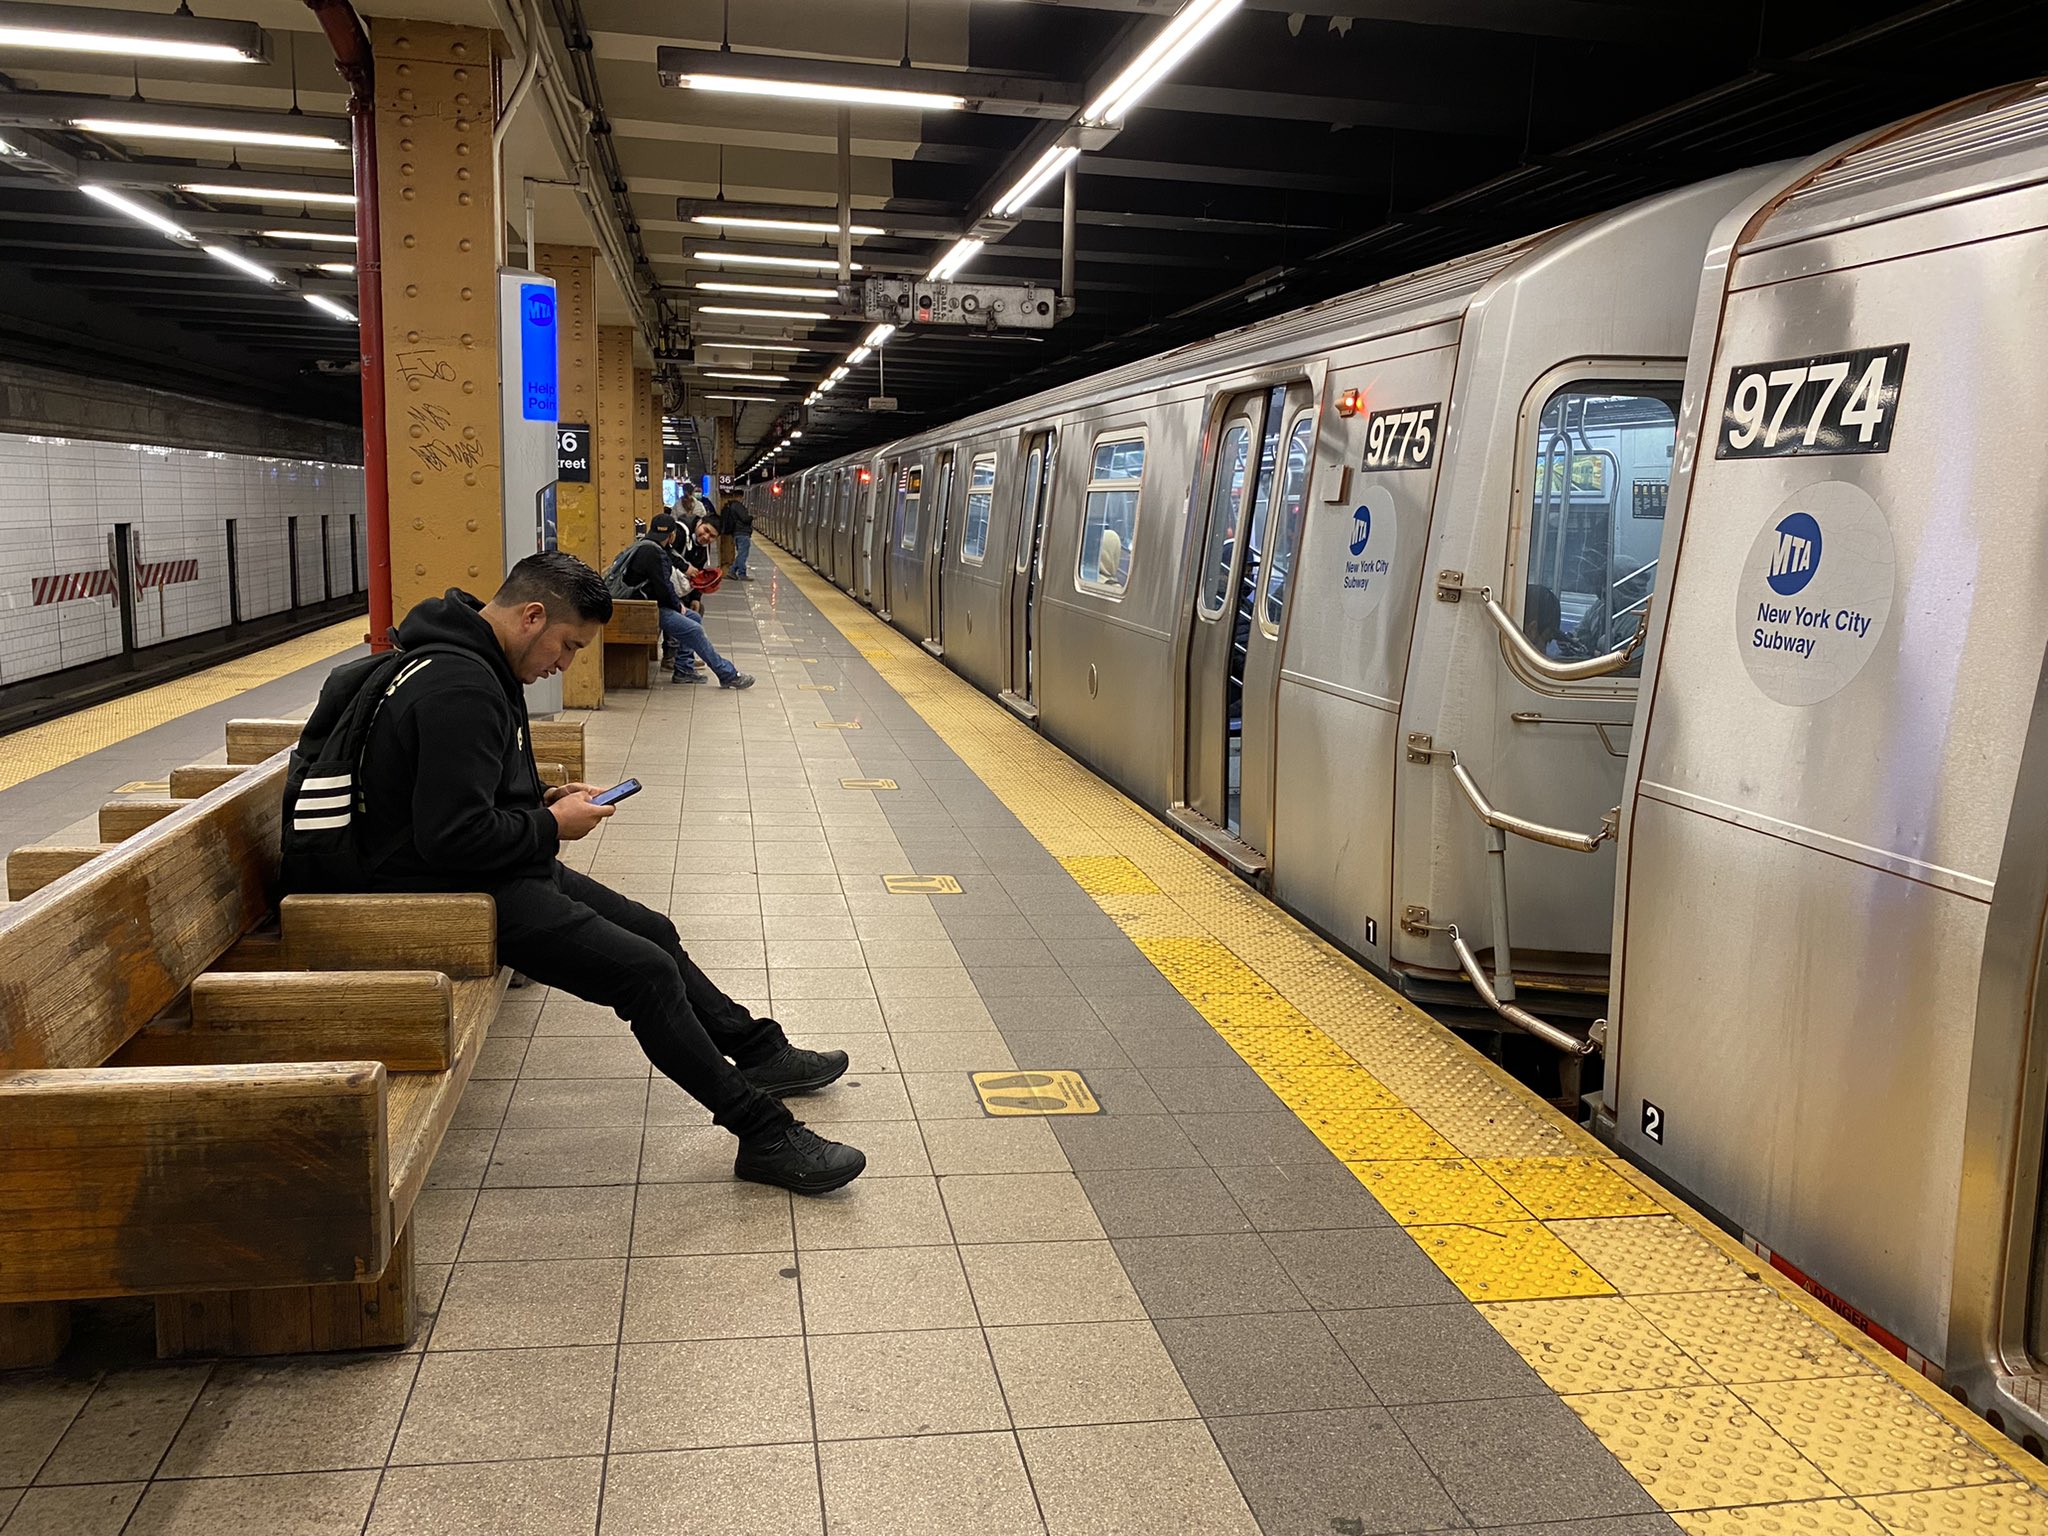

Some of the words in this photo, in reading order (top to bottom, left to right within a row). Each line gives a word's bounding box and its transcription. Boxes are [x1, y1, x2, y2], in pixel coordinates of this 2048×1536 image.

[529, 300, 552, 320] MTA
[528, 382, 555, 396] Help
[528, 398, 556, 410] Poin
[1729, 356, 1888, 450] 9774
[556, 432, 578, 453] 6
[1367, 409, 1434, 466] 9775
[720, 475, 731, 484] 36
[1351, 517, 1367, 546] MTA
[1767, 530, 1812, 577] MTA
[1345, 561, 1359, 573] New
[1360, 560, 1375, 572] York
[1375, 559, 1389, 575] City
[1343, 576, 1369, 591] Subway
[1757, 602, 1792, 624] New
[1795, 606, 1831, 629] York
[1835, 610, 1872, 638] City
[1752, 628, 1816, 659] Subway
[1368, 920, 1373, 942] 1
[1645, 1106, 1660, 1140] 2
[1813, 1284, 1868, 1334] DANGER
